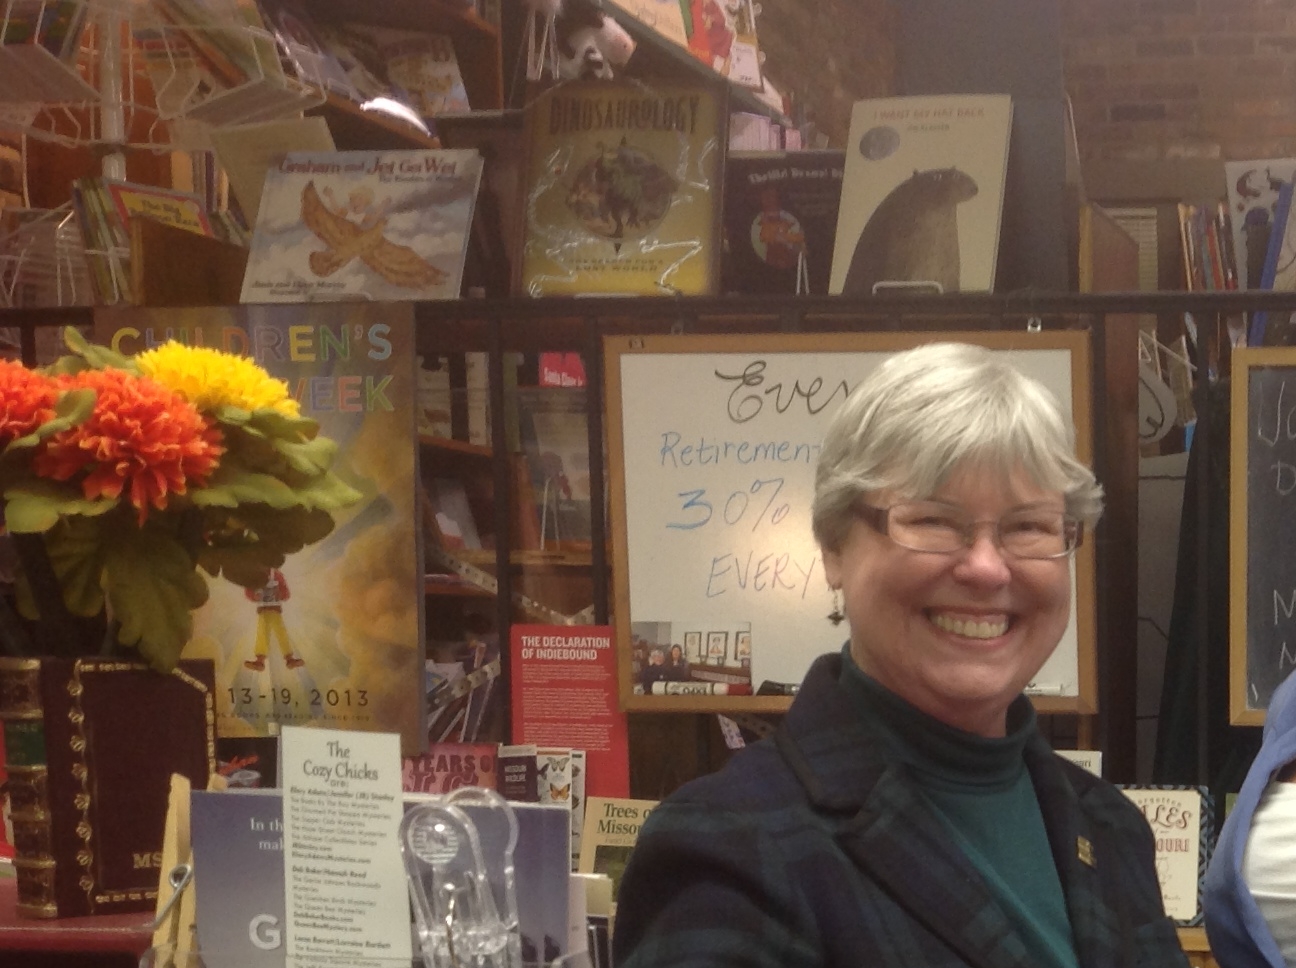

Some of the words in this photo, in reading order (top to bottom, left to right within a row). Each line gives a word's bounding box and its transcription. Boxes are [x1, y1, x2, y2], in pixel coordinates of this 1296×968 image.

[660, 432, 821, 467] Retiremen
[665, 478, 790, 533] 30%
[521, 636, 540, 647] THE
[542, 637, 611, 649] DECLARATION
[522, 649, 534, 660] OF
[536, 649, 598, 661] INDIEBOUND
[310, 689, 369, 707] 2013
[327, 740, 351, 759] The
[303, 760, 333, 782] Cozy
[335, 762, 379, 781] Chicks
[603, 803, 639, 819] Trees
